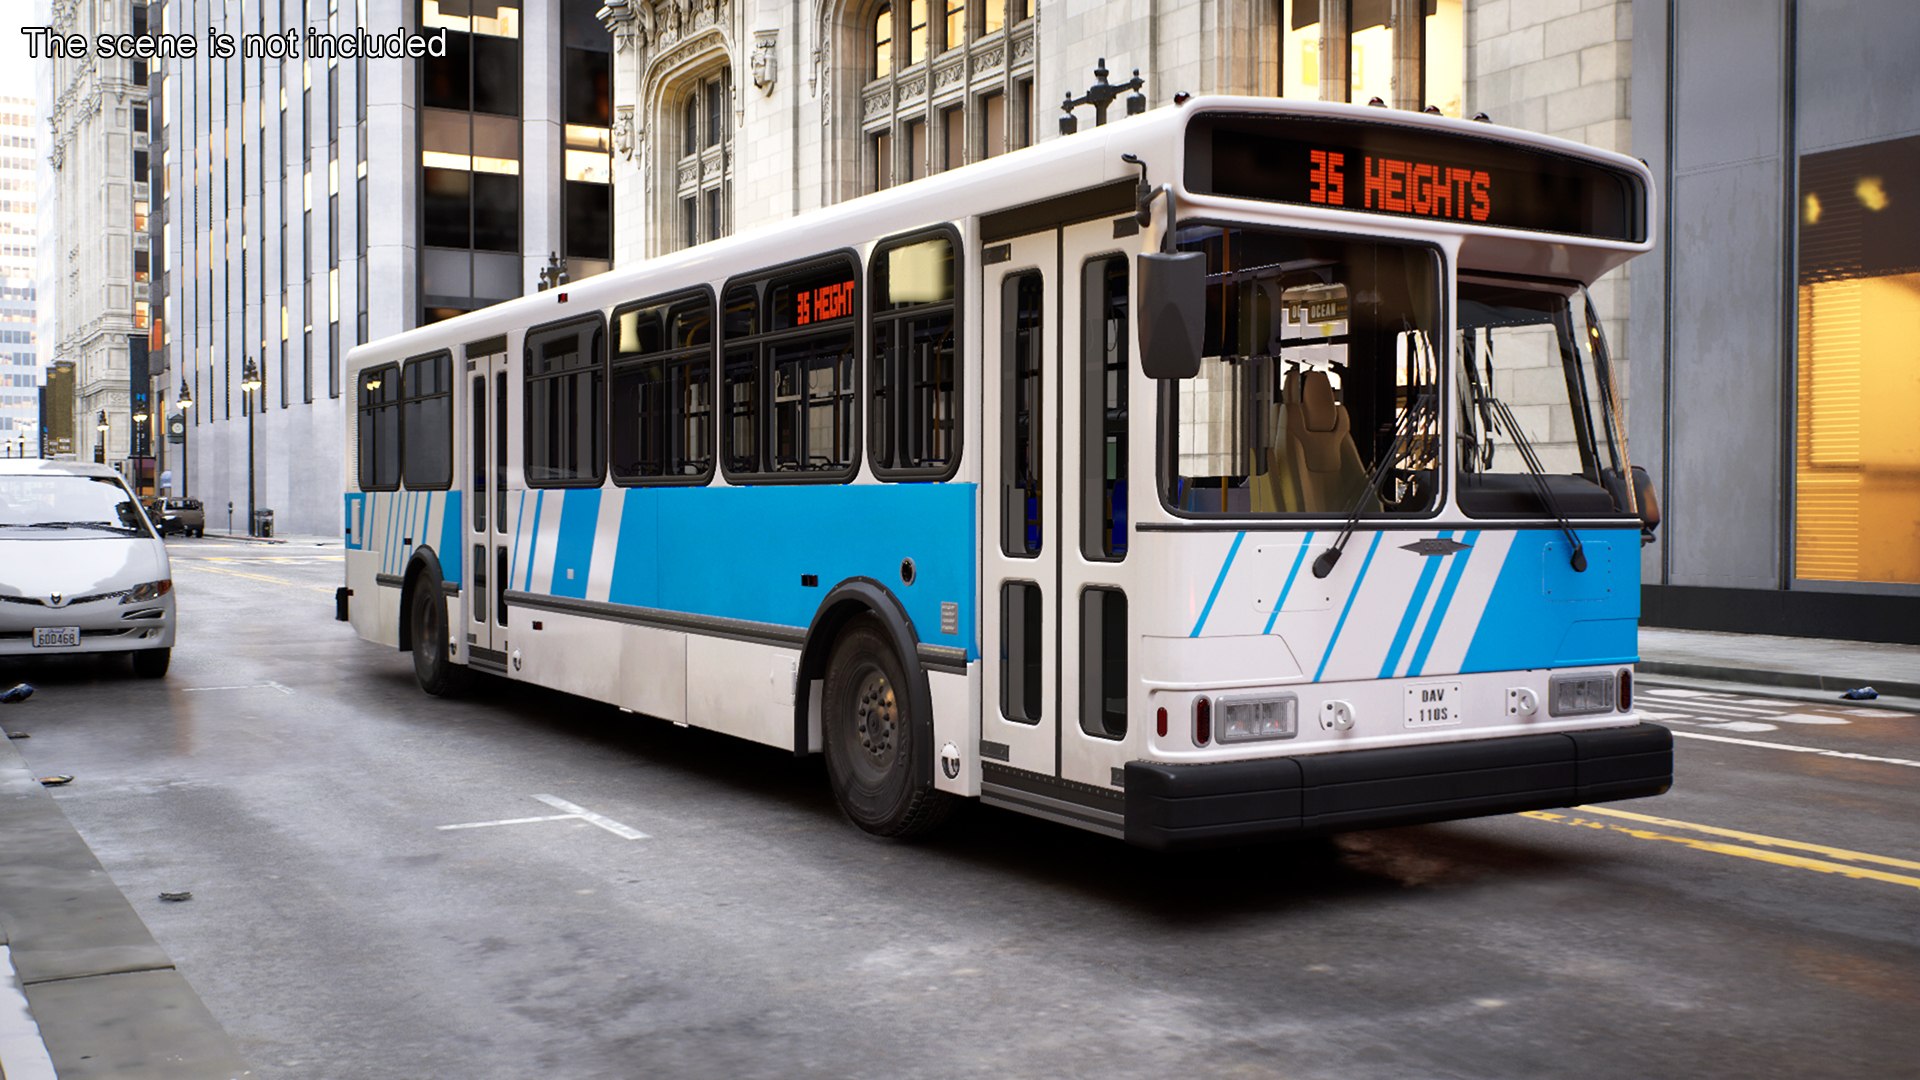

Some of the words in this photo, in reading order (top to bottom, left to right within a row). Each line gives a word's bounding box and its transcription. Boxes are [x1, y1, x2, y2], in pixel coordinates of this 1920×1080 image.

[1310, 149, 1345, 206] 35
[1364, 156, 1491, 222] HEIGHTS
[797, 291, 810, 326] 35
[1311, 302, 1336, 319] OCEAN
[1421, 688, 1445, 703] DAV
